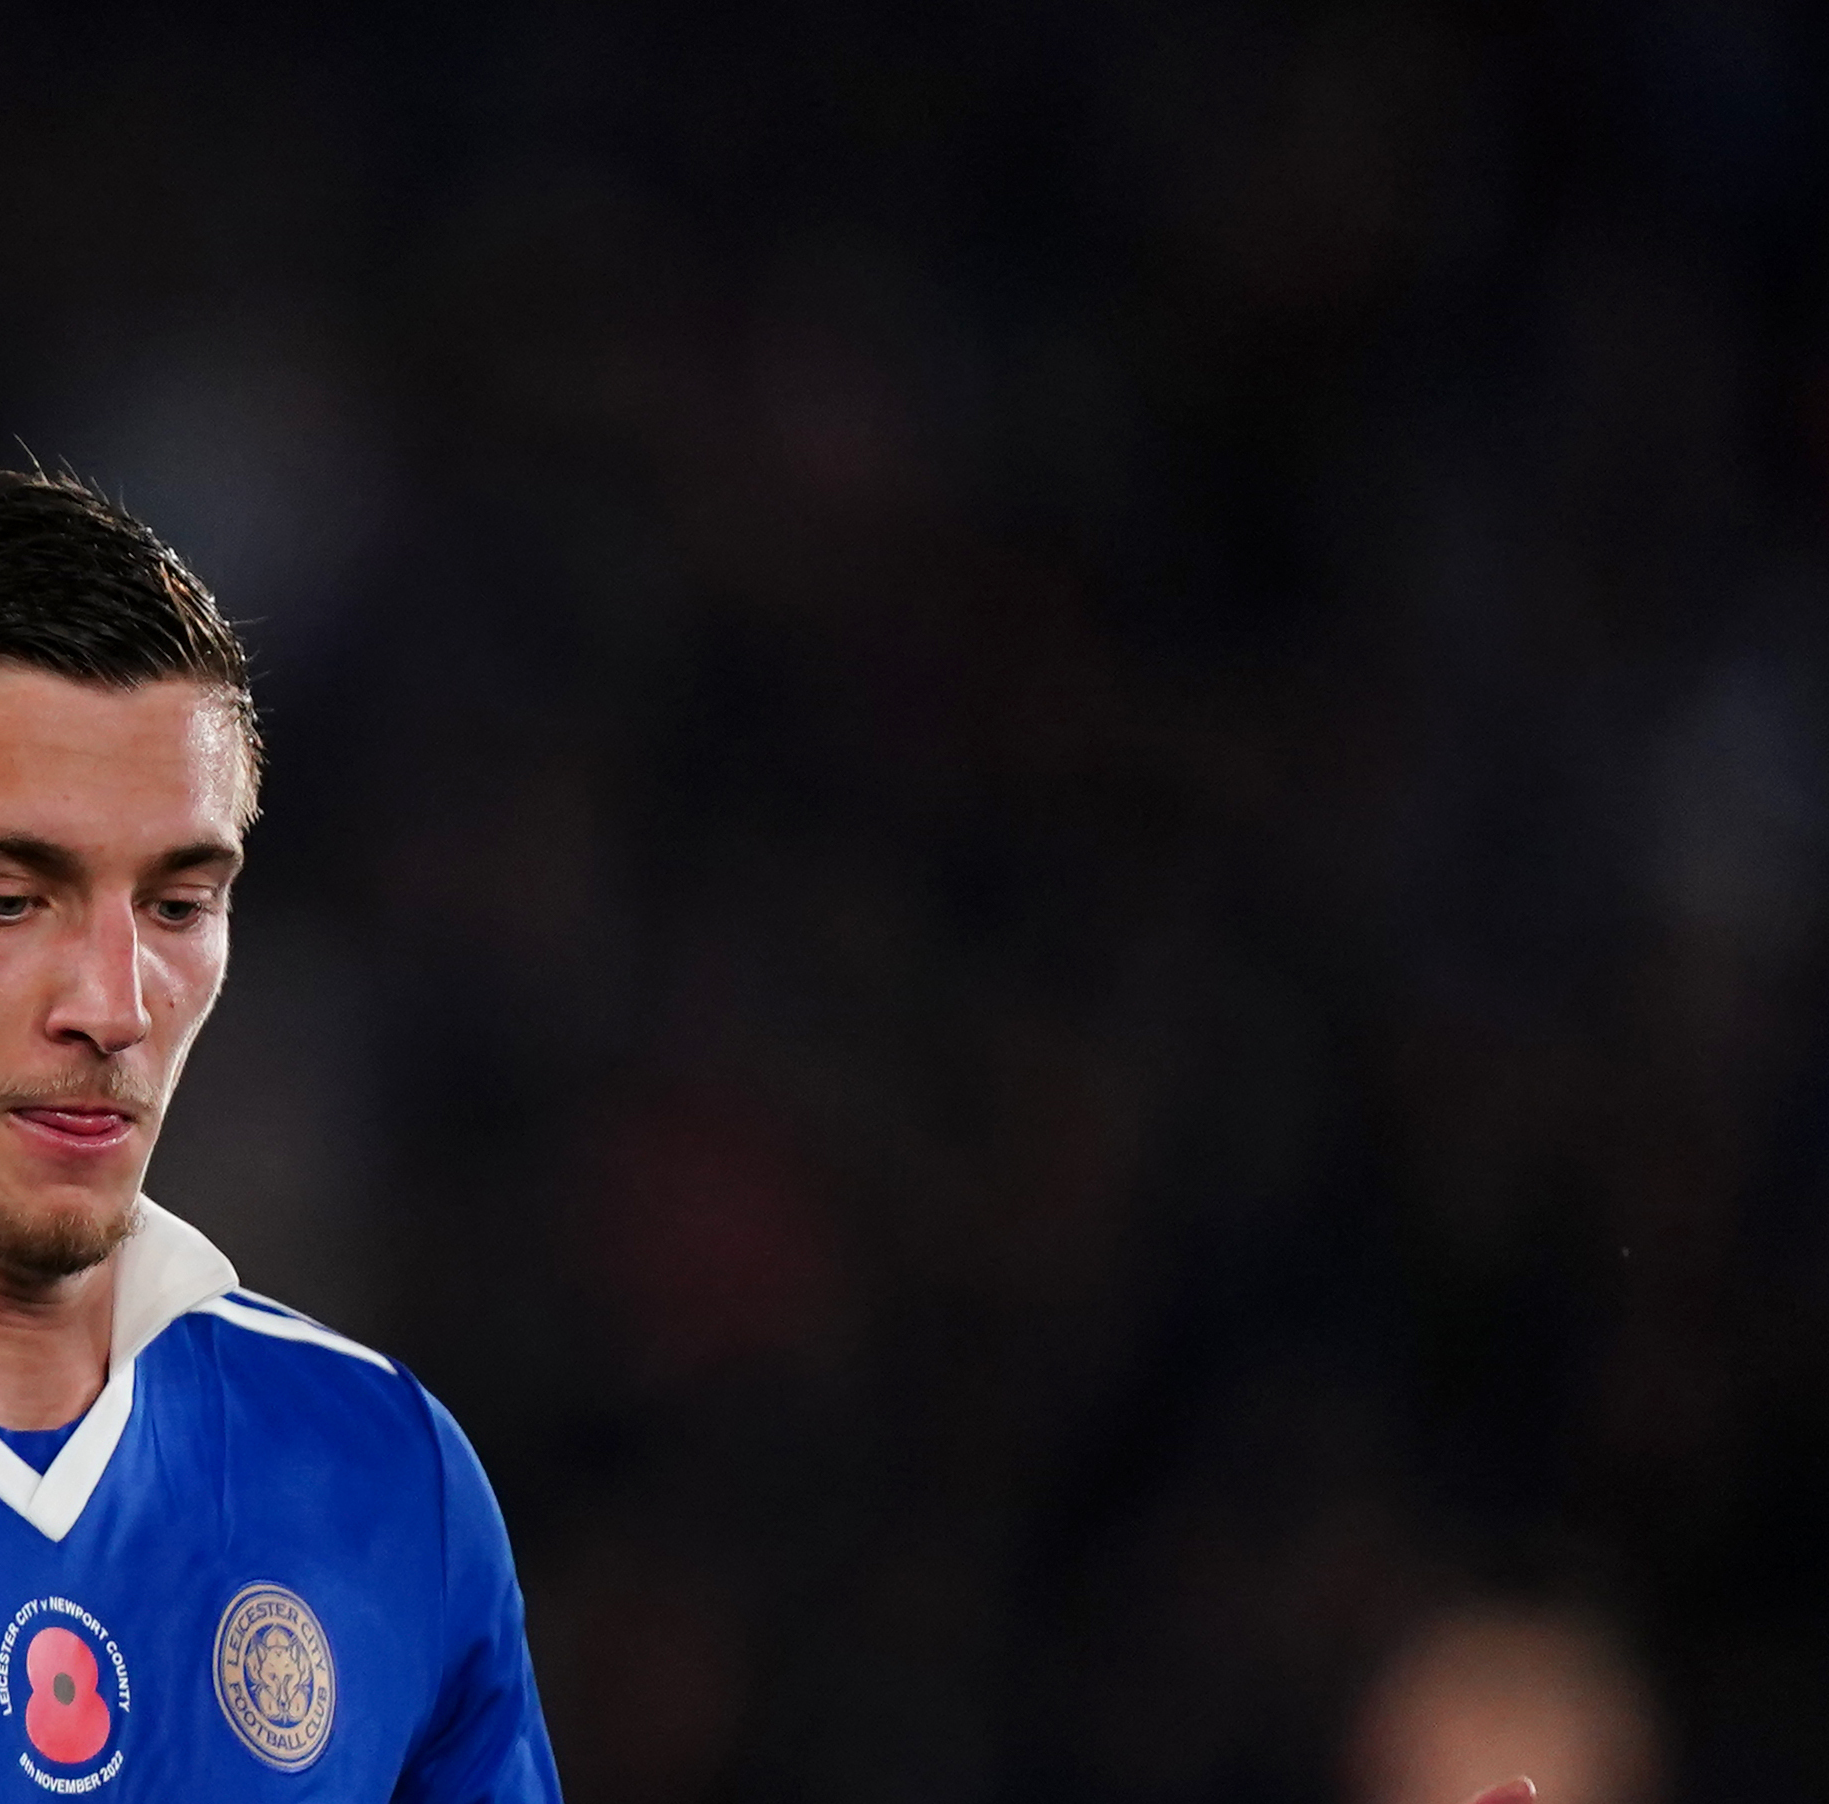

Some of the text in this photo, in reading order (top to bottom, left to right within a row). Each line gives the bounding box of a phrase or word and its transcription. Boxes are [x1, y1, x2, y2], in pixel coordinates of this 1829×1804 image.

[15, 1599, 39, 1627] CITY
[49, 1596, 110, 1641] NEWPORT
[106, 1640, 131, 1713] COUNTY
[227, 1601, 327, 1672] LEICESTER CITY
[229, 1682, 328, 1750] FOOTBALL CLUB
[19, 1750, 125, 1794] 8th NOVEMBER 2022
